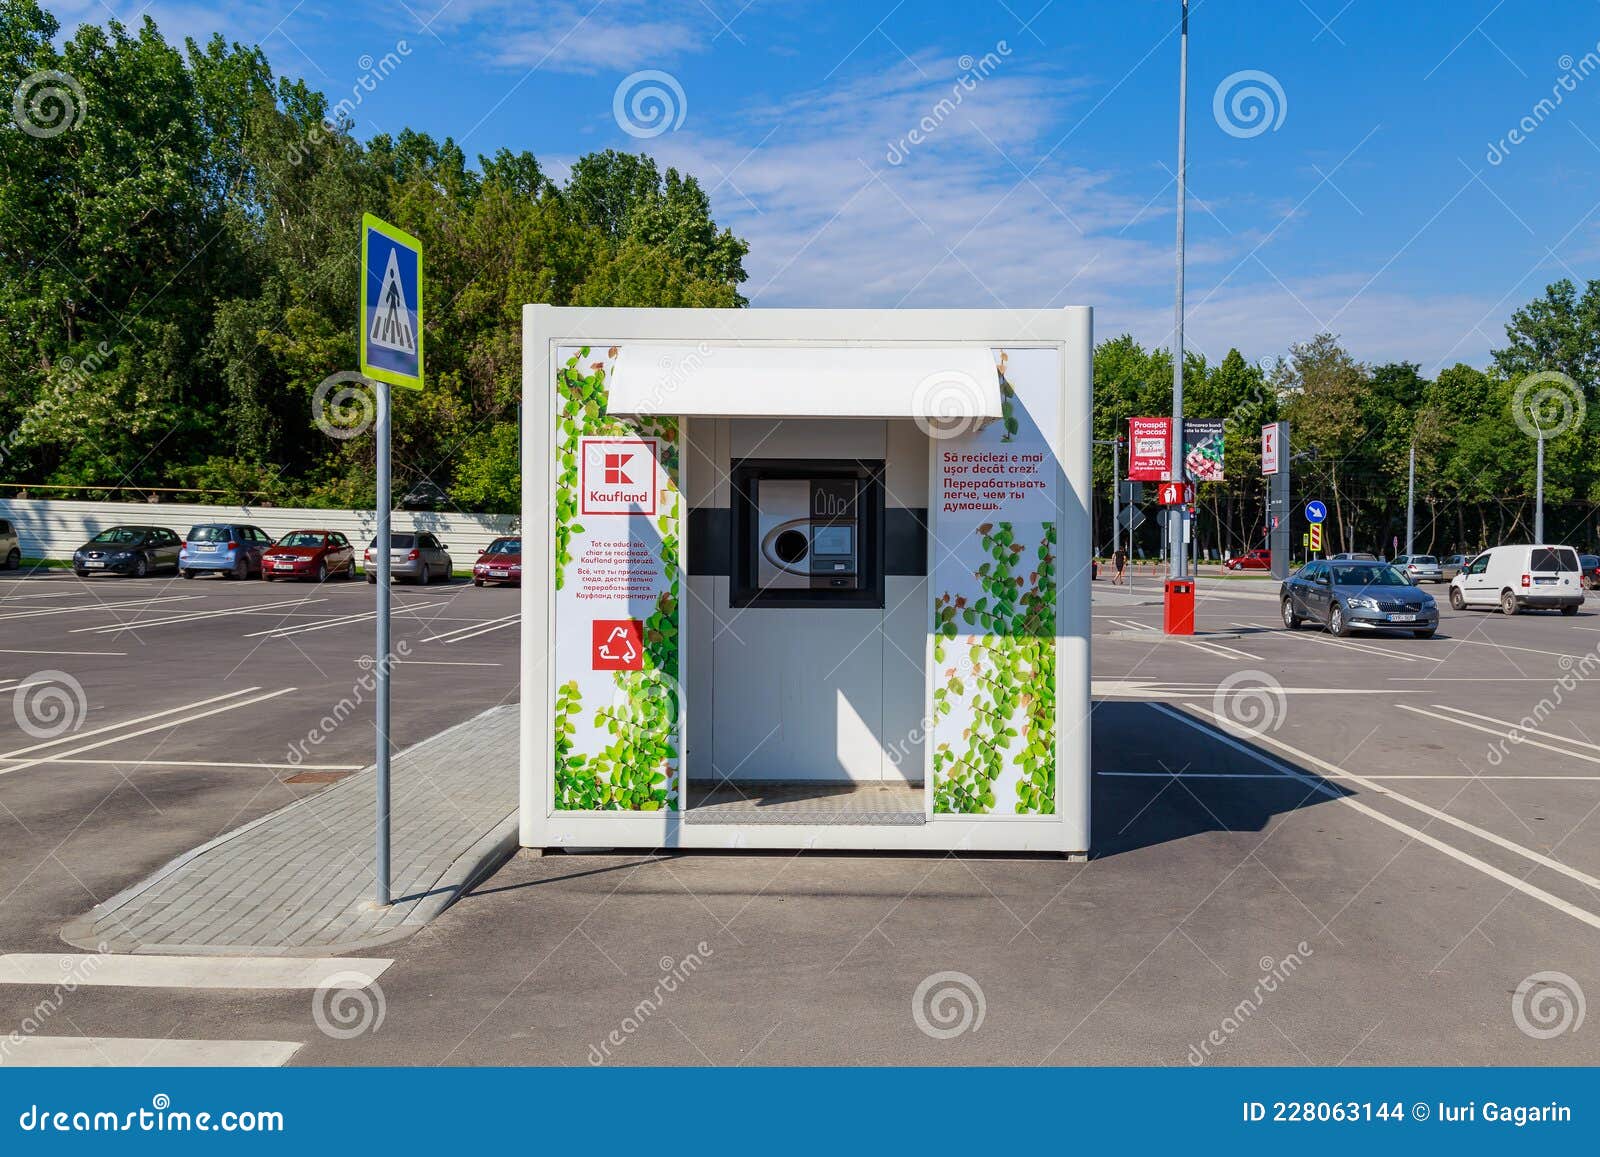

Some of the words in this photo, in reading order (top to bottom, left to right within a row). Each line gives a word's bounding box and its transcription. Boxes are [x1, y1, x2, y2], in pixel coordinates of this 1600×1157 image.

[943, 452, 958, 463] Să
[962, 452, 1008, 463] reciclezi
[1011, 455, 1018, 463] e
[1022, 453, 1043, 463] mai
[943, 465, 968, 476] ușor
[972, 464, 1005, 473] decât
[943, 478, 1046, 490] Перерабатывать
[590, 490, 648, 502] Kaufland
[943, 491, 980, 500] легче,
[983, 491, 1006, 499] чем
[1009, 491, 1025, 499] ты
[943, 502, 1002, 512] думаешь.
[590, 540, 602, 548] Tot
[613, 540, 632, 548] aduci
